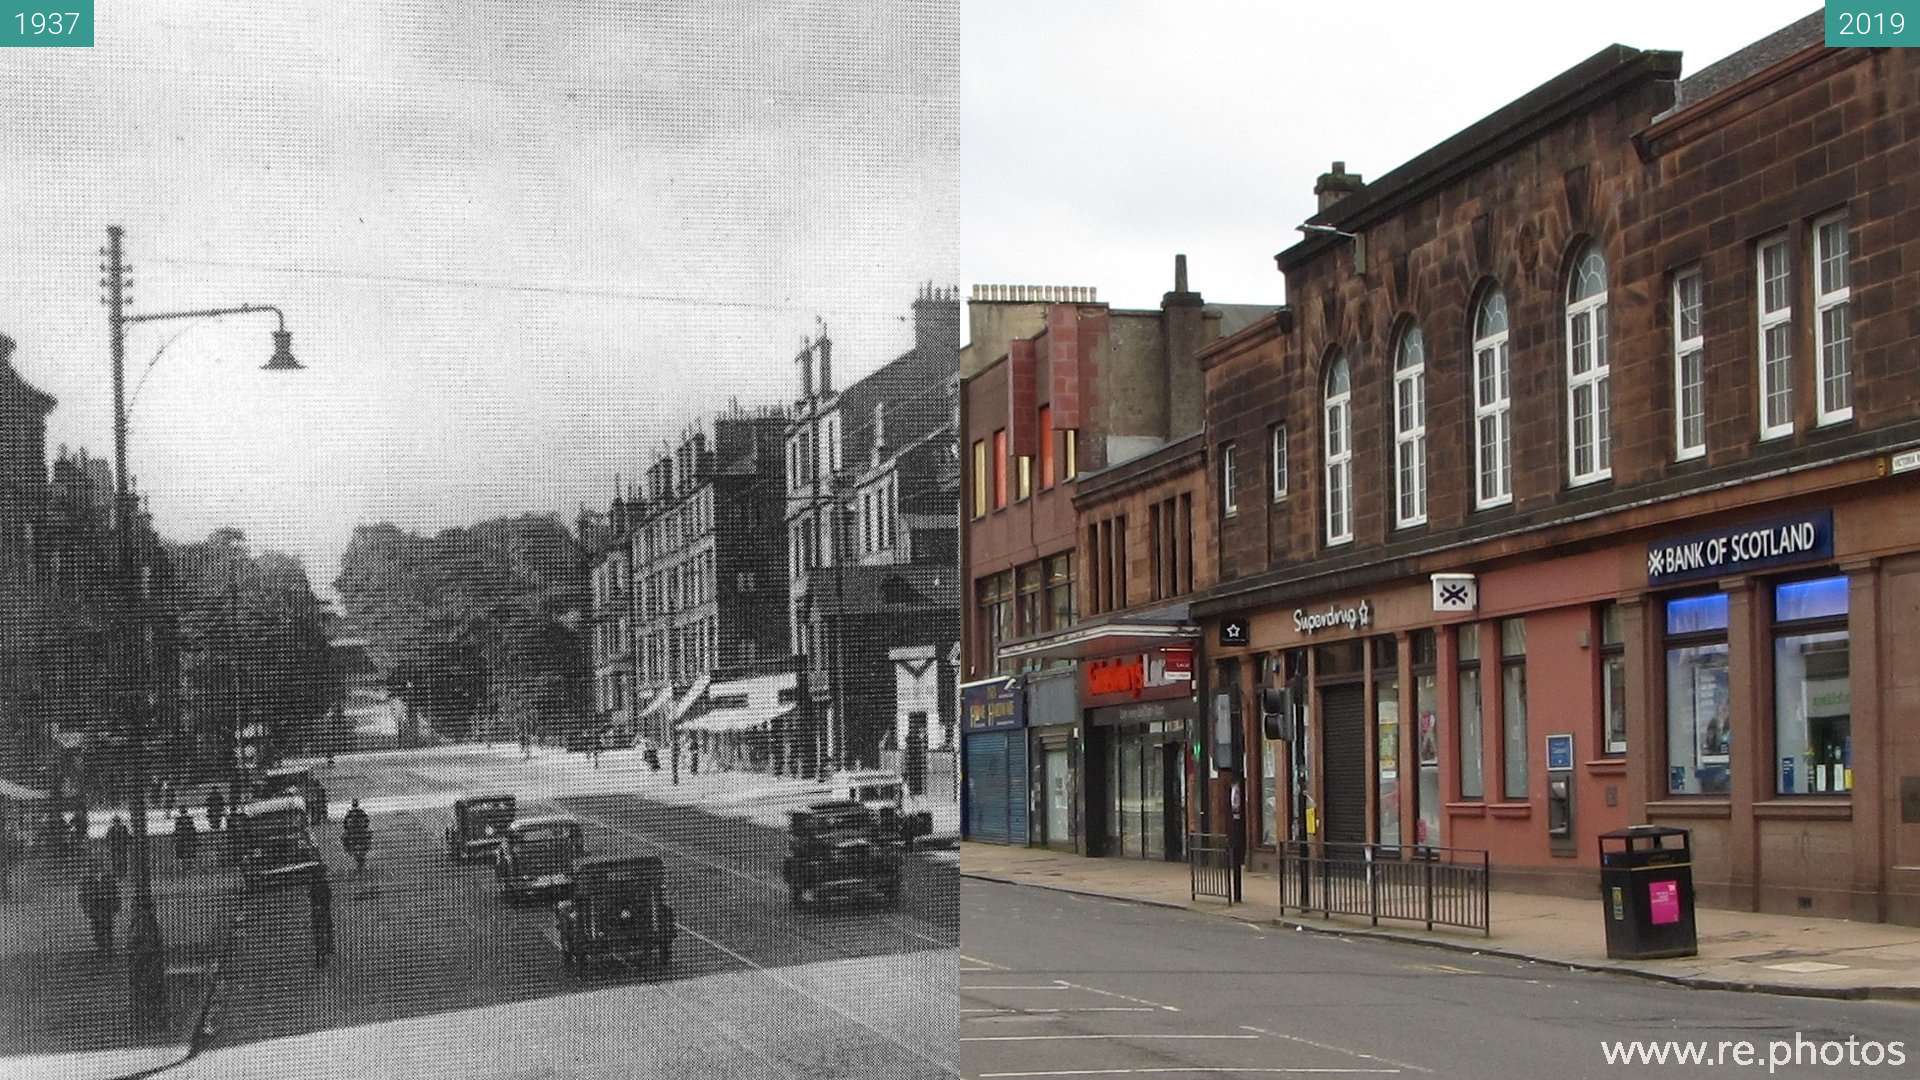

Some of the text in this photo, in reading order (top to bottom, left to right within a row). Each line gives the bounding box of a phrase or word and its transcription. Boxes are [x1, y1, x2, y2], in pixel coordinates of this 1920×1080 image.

[1665, 522, 1815, 573] BANK OF SCOTLAND
[1292, 605, 1356, 635] Superdrug
